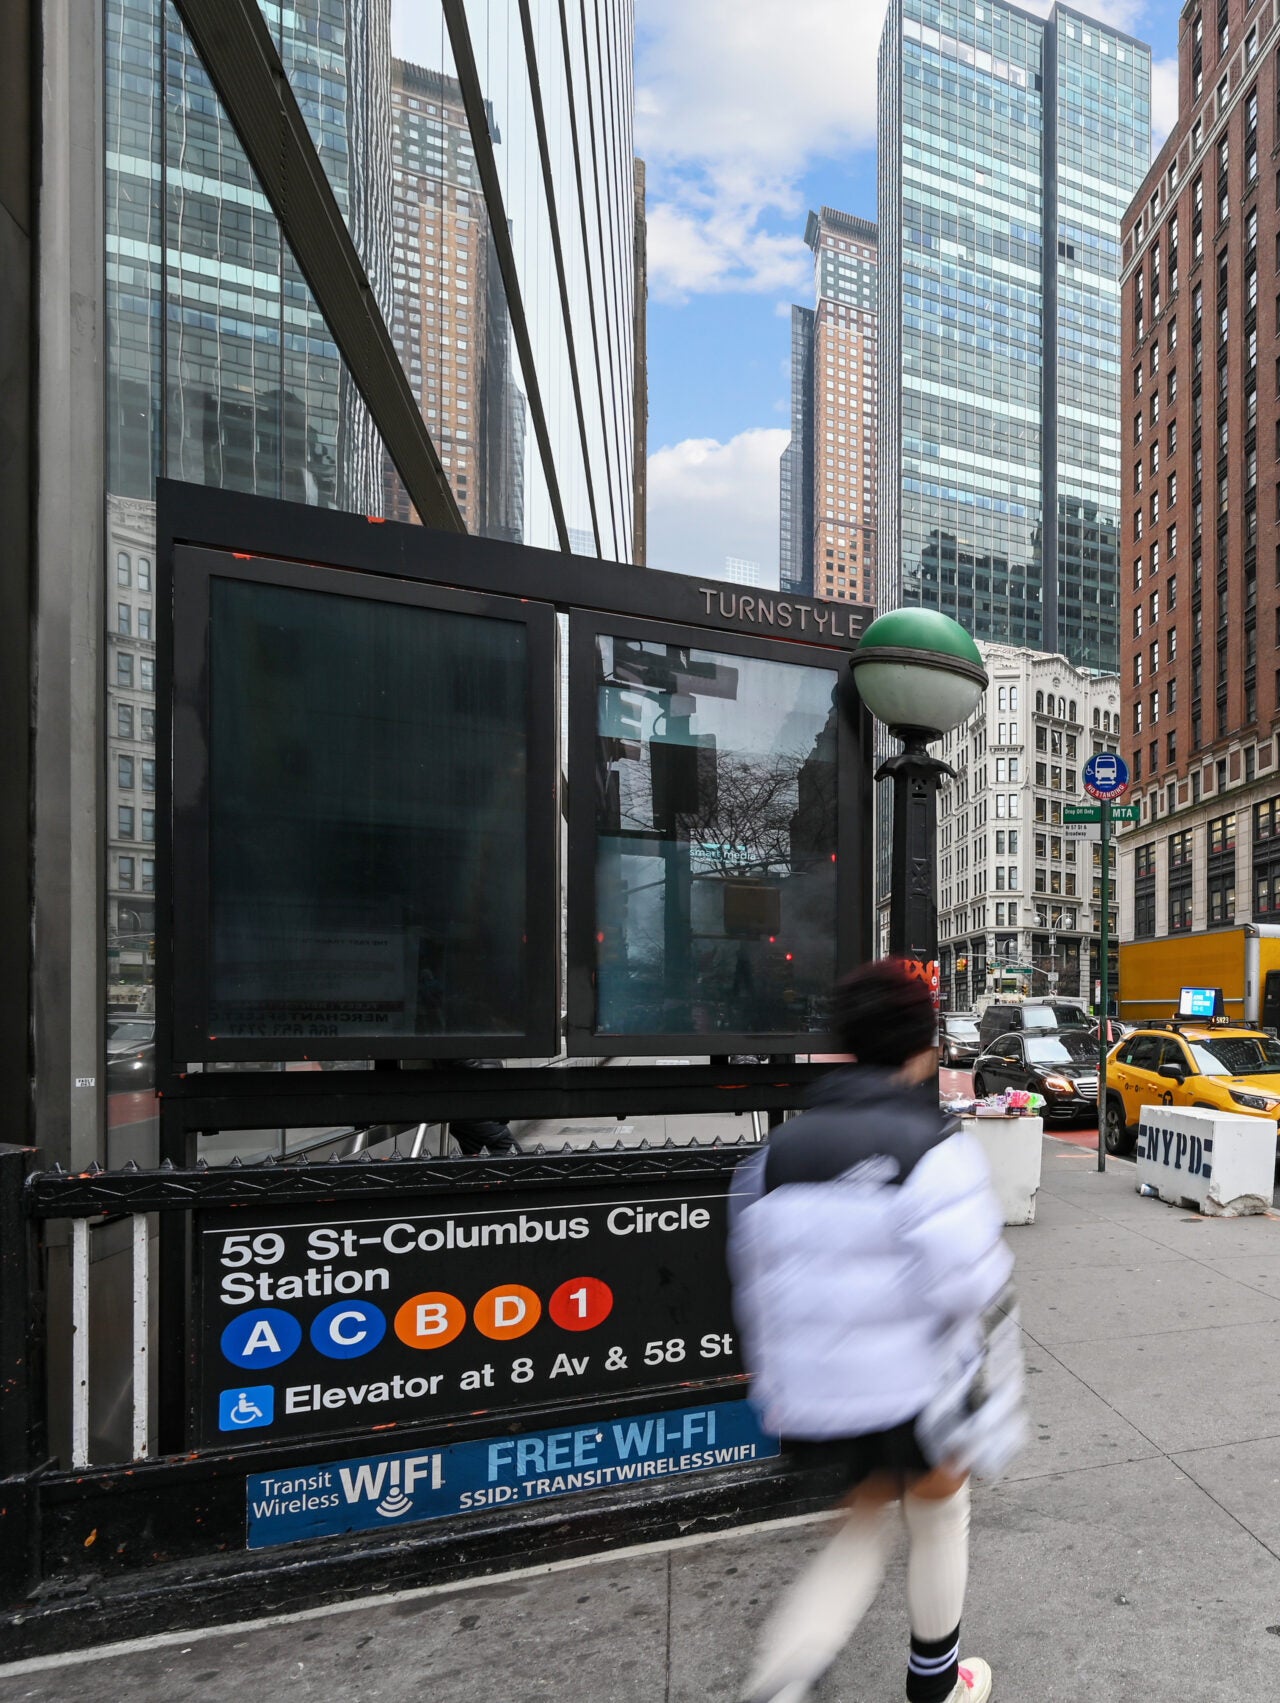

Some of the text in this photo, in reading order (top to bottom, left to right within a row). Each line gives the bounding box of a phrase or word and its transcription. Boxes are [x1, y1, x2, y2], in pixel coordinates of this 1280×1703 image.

[698, 587, 864, 640] TURNSTYLE
[1087, 784, 1125, 798] NO STANDING
[1112, 808, 1133, 818] MTA
[723, 851, 756, 860] media
[1146, 1125, 1203, 1175] NYPD
[220, 1232, 285, 1268] 59
[606, 1203, 711, 1236] Circle
[219, 1265, 390, 1305] Station
[241, 1288, 587, 1356] A C B D 1
[285, 1333, 733, 1414] Elevator at 8 Av & 58 St
[487, 1410, 716, 1481] FREE WI-FI
[260, 1471, 332, 1498] Transit
[459, 1443, 756, 1509] SSID: TRANSITWIRELESSWIFI
[252, 1492, 340, 1519] Wireless
